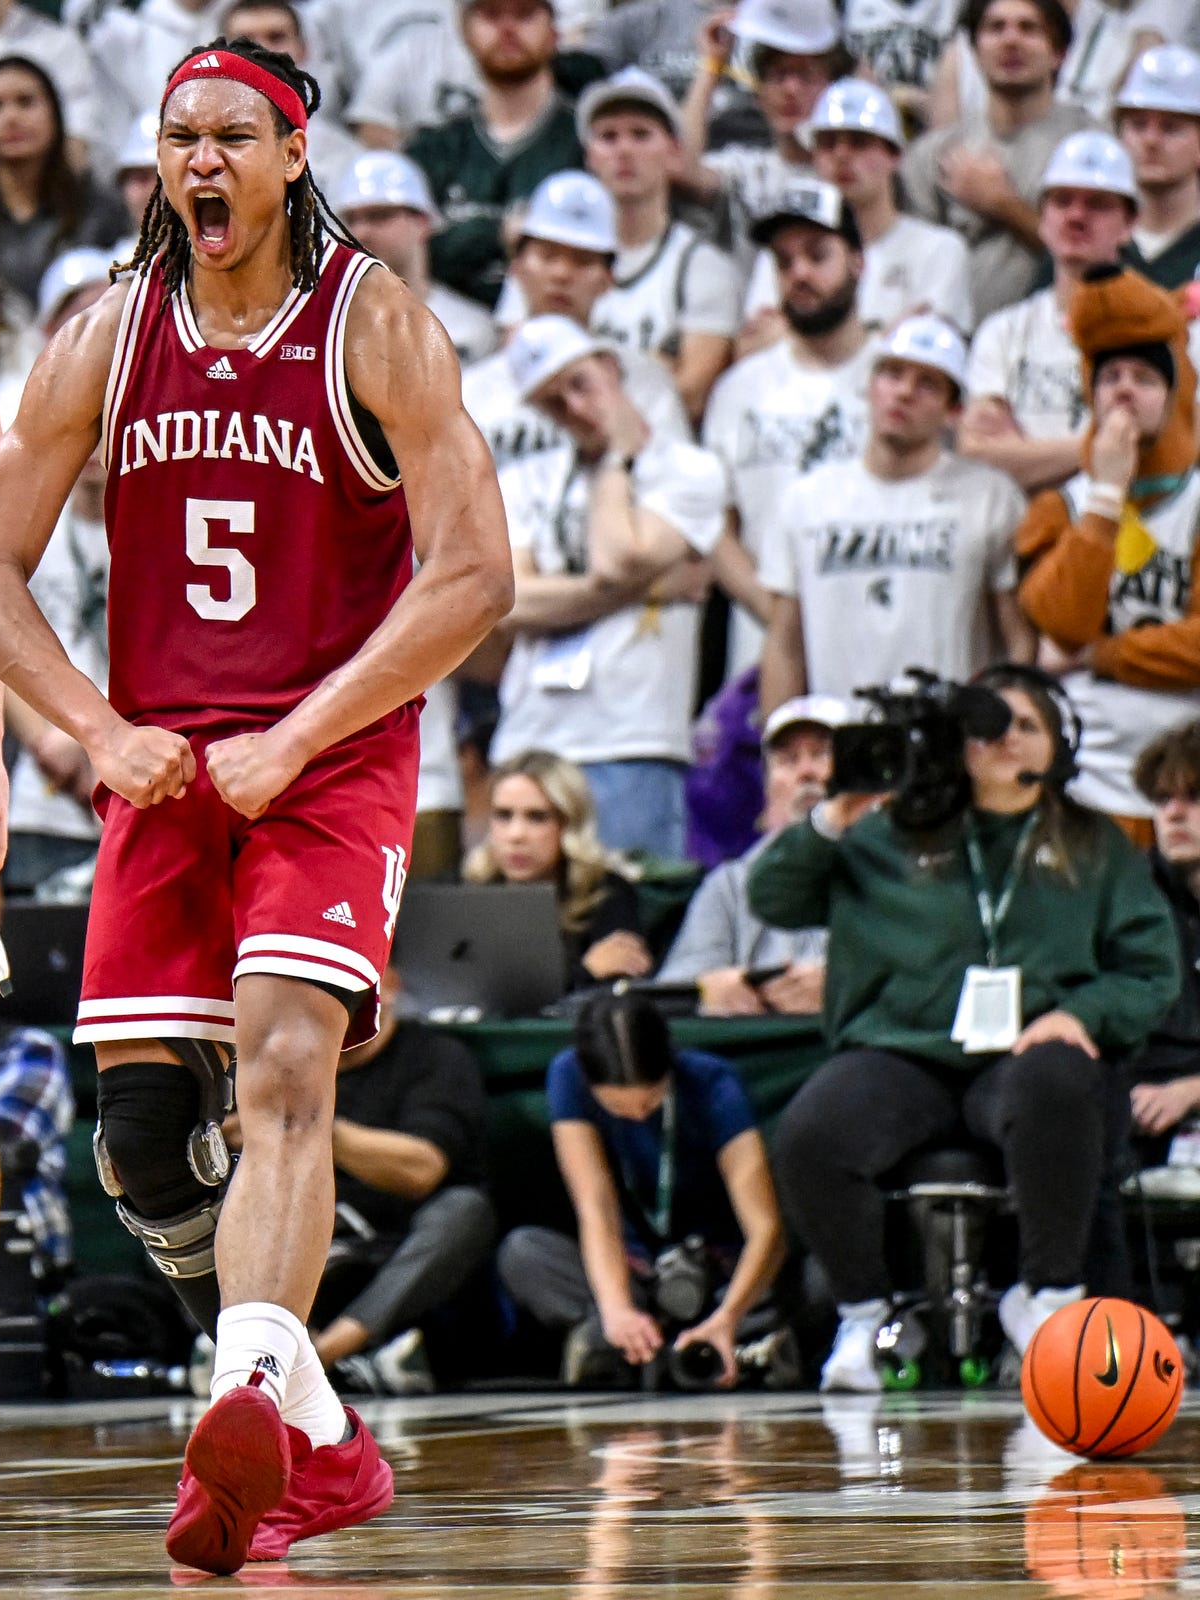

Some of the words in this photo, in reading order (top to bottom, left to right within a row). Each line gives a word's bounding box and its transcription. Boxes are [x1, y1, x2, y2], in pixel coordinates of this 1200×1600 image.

[206, 370, 238, 380] adidas
[119, 410, 324, 485] INDIANA
[185, 497, 257, 622] 5
[322, 910, 357, 929] adidas
